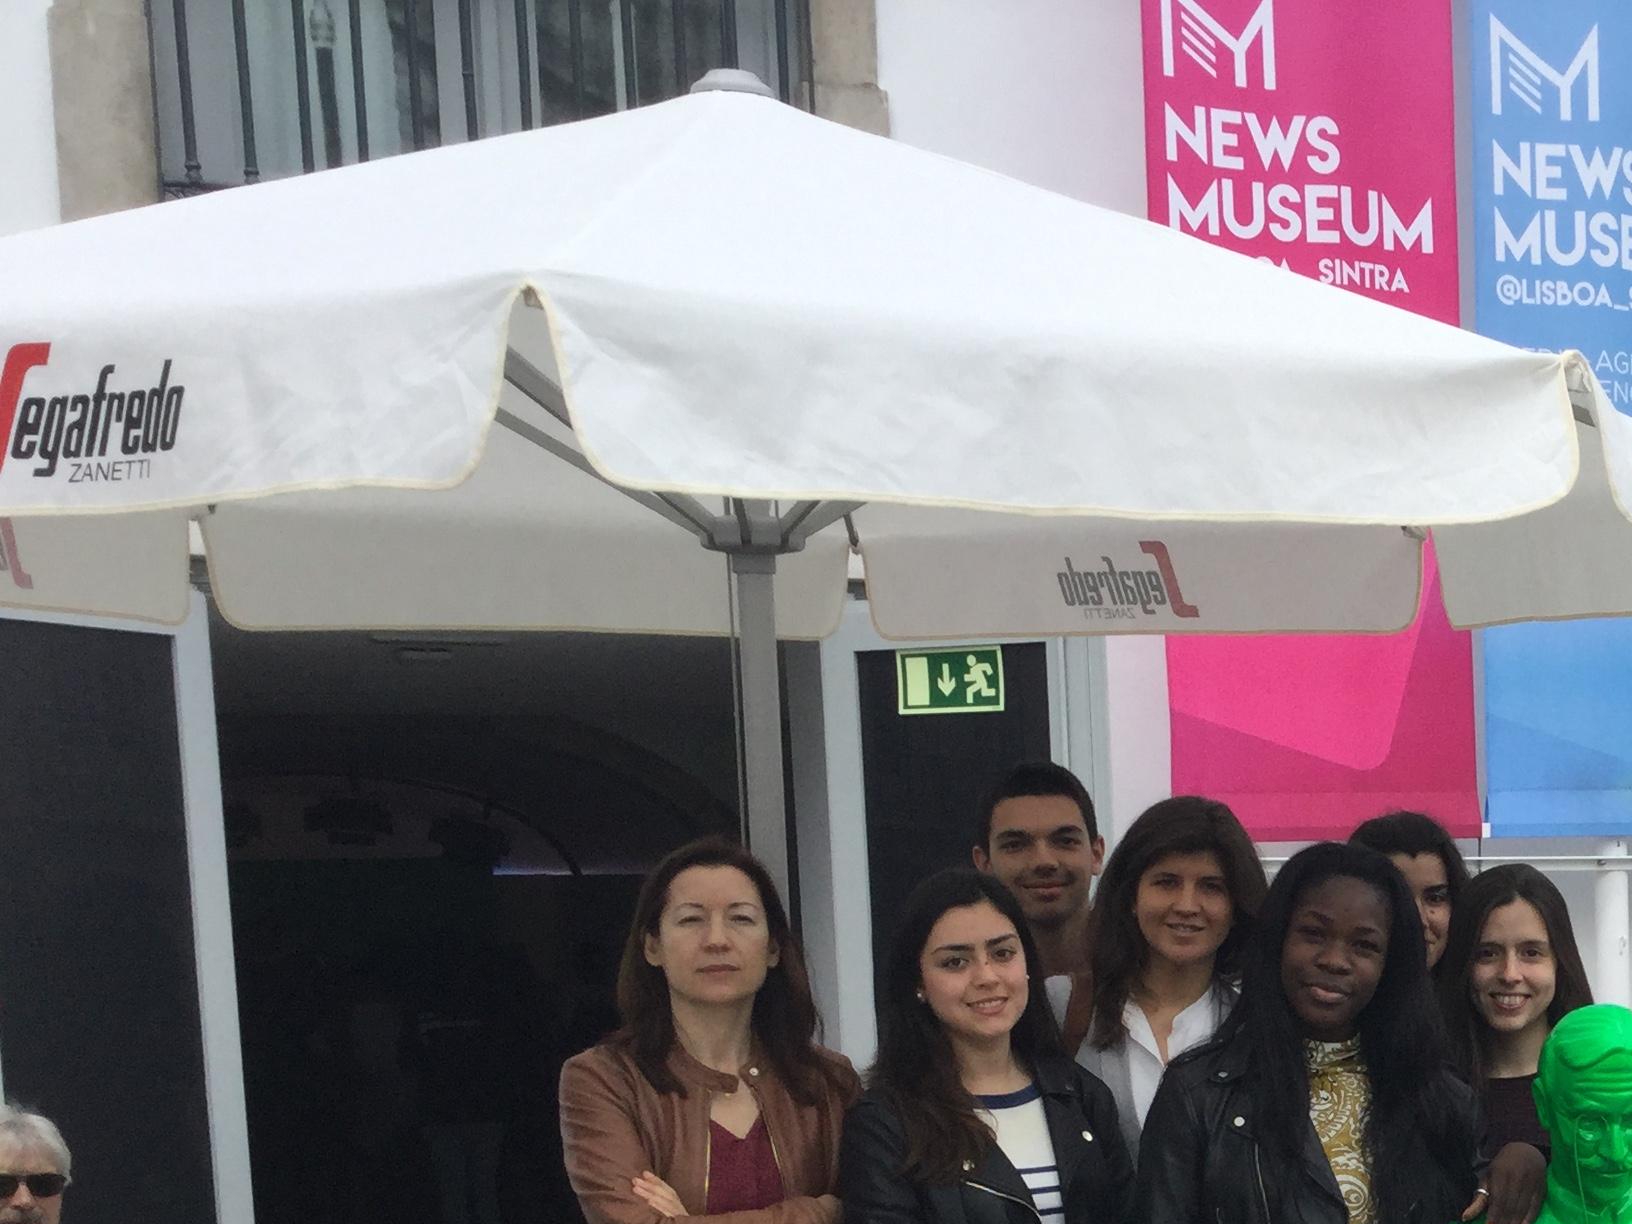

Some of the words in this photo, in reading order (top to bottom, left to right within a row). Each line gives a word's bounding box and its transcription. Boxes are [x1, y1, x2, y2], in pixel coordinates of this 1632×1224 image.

[1165, 102, 1341, 175] NEWS
[1166, 172, 1434, 254] MUSEUM
[68, 458, 151, 484] ZANETTI
